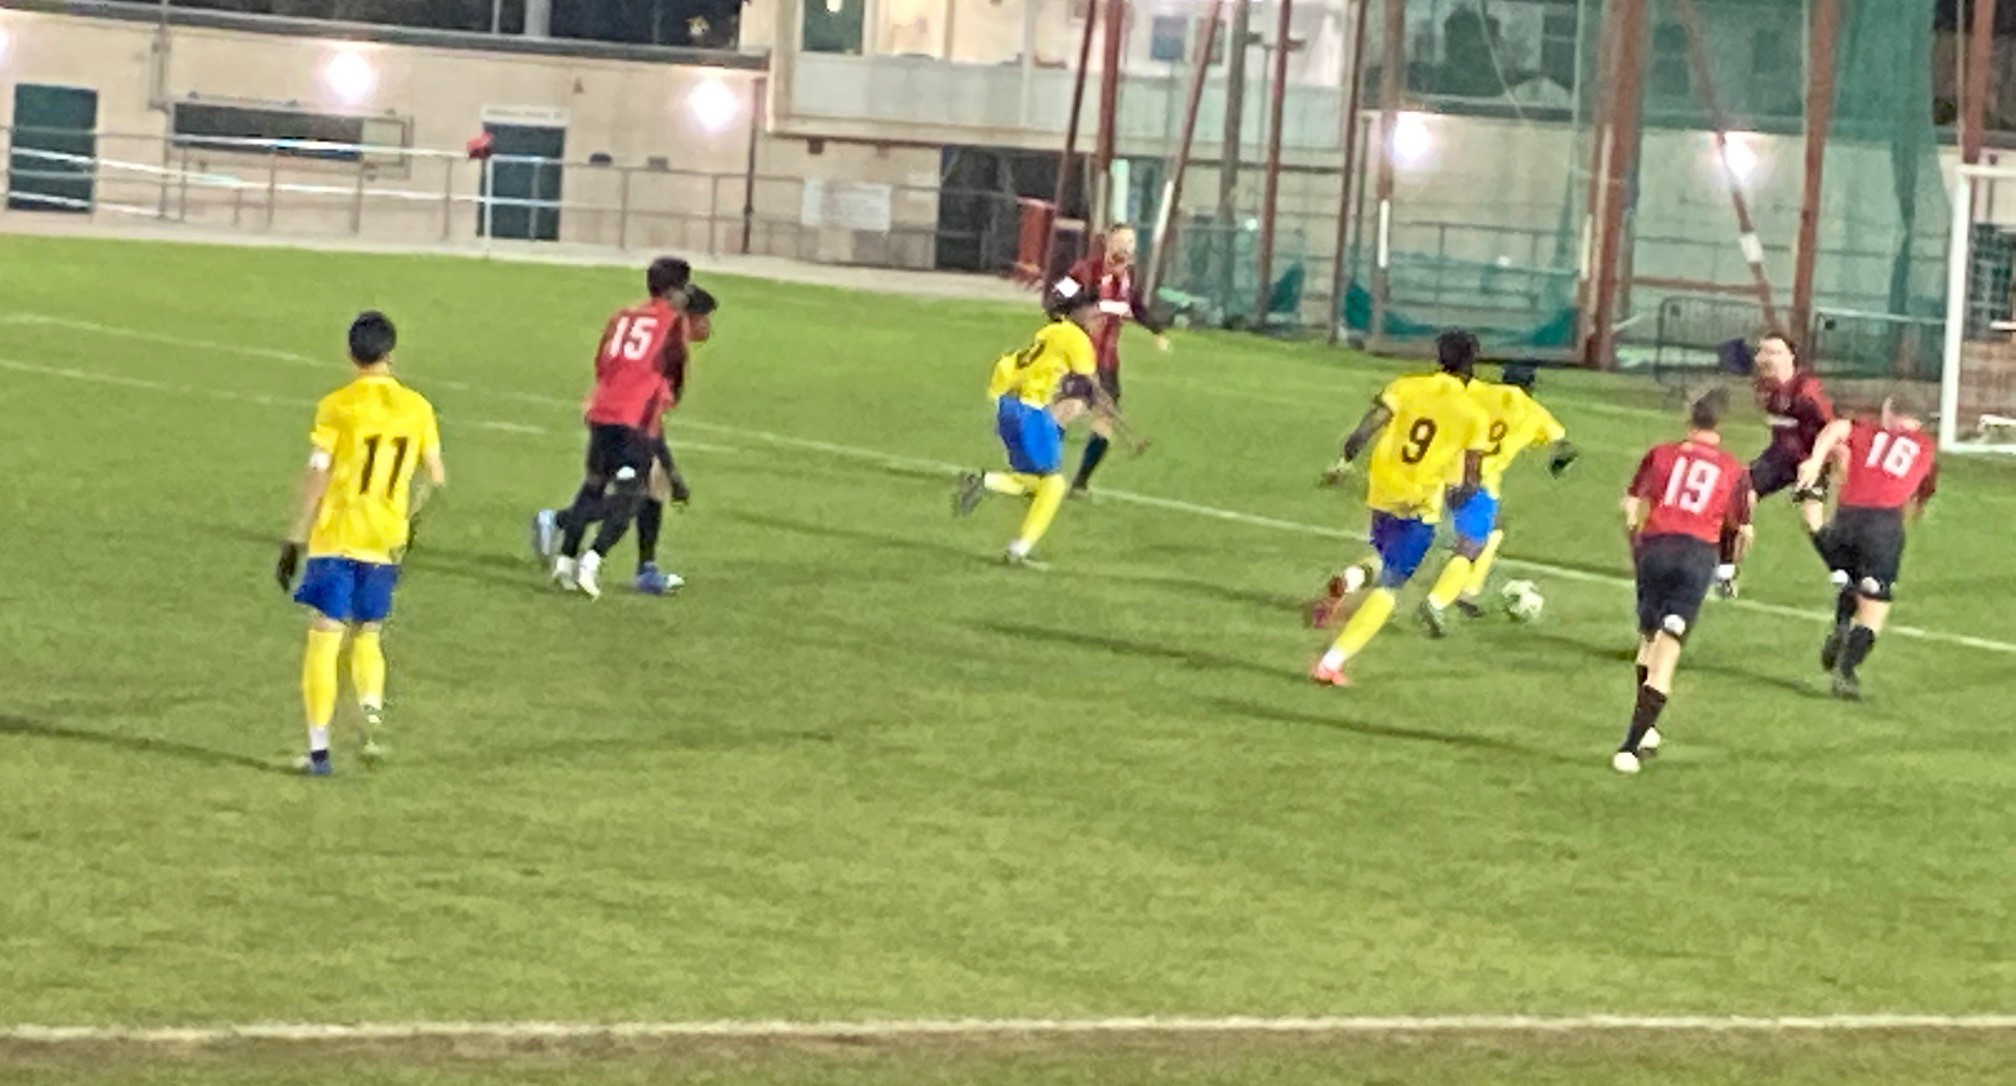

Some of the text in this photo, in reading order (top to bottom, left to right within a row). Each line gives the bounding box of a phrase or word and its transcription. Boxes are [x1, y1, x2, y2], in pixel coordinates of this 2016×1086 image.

[608, 315, 658, 360] 15
[359, 433, 409, 500] 11
[1401, 417, 1437, 464] 9
[1663, 456, 1721, 514] 19
